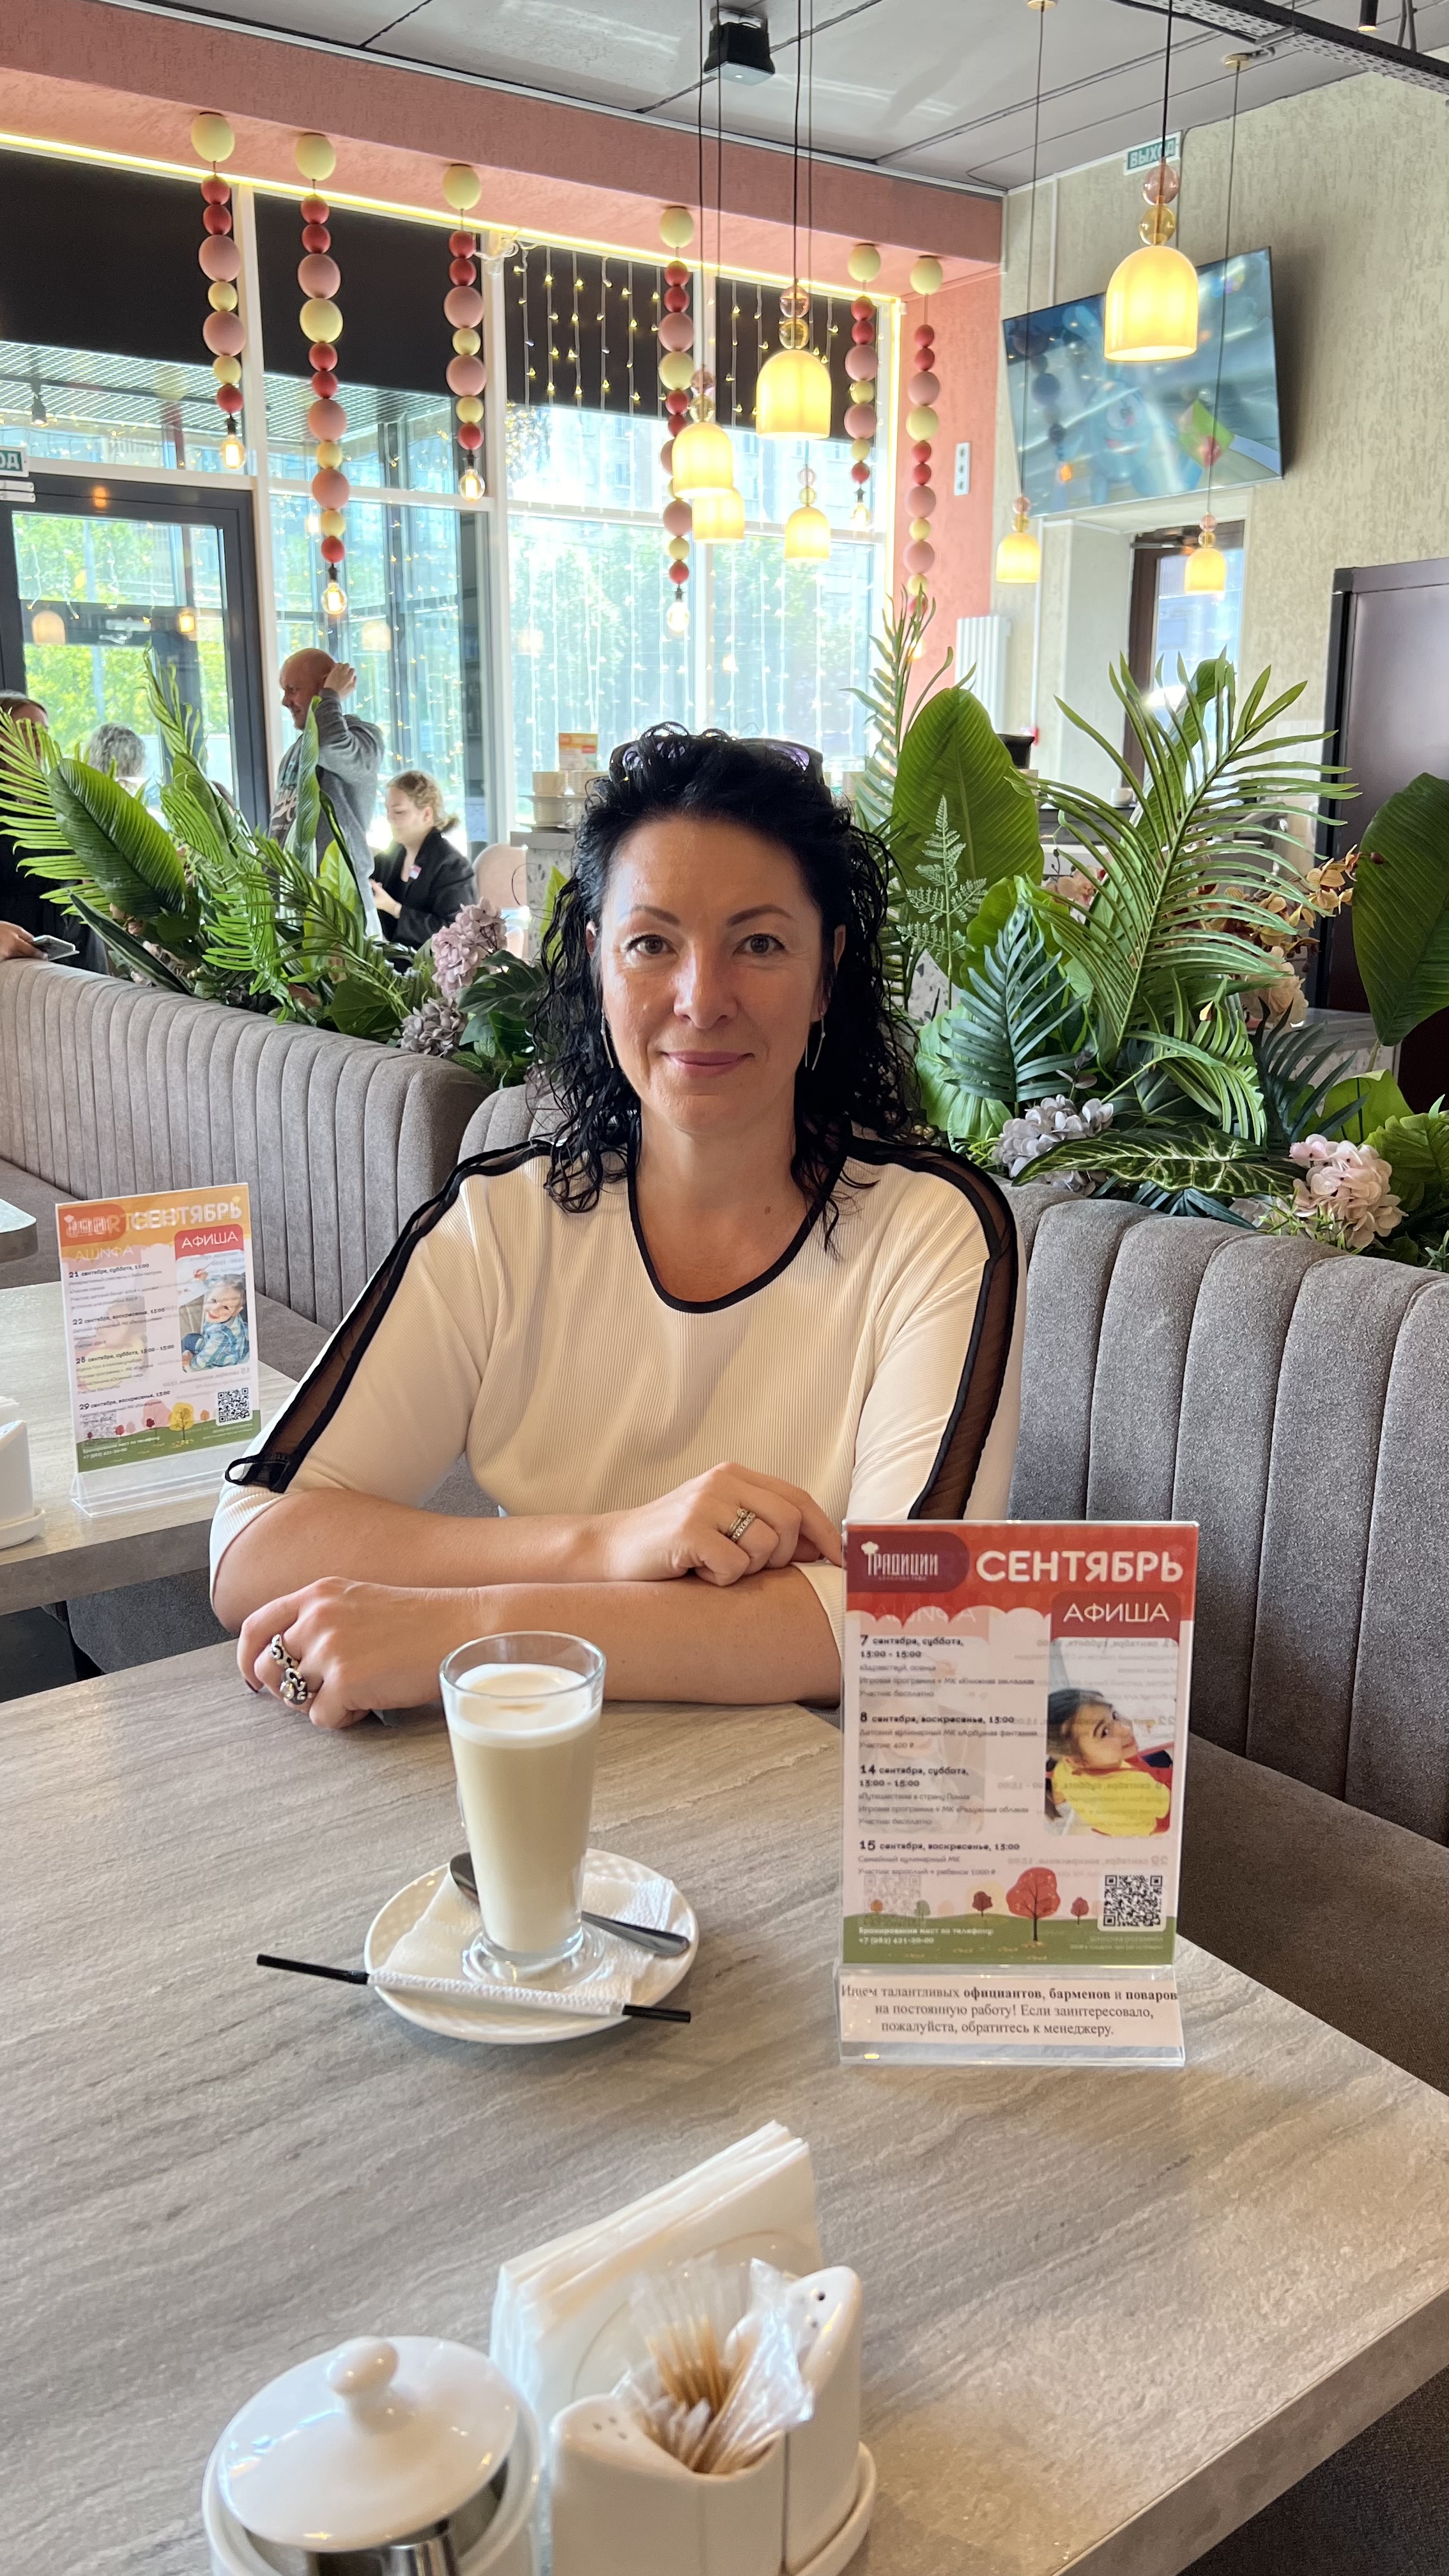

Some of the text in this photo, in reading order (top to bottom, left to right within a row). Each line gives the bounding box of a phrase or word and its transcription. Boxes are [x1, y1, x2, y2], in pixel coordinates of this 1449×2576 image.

[130, 1201, 243, 1230] СЕНТЯБРЬ
[181, 1230, 238, 1250] АФИША
[79, 1402, 89, 1411] 29
[864, 1549, 1184, 1584] ТРАДИЦИИ СЕНТЯБРЬ
[1062, 1602, 1170, 1623] АФИША
[860, 1634, 965, 1647] 7 сентября, суббота,
[860, 1712, 868, 1722] 8
[872, 1715, 919, 1724] сентября,
[860, 1764, 876, 1775] 14
[928, 1767, 969, 1776] суббота,
[859, 1840, 875, 1850] 15
[879, 1843, 926, 1851] сентября,
[841, 1985, 1177, 2004] Ищем талантливых официантов, барменов и поваров
[875, 2004, 1154, 2020] на постоянную работу! Если заинтересовало,
[882, 2020, 1114, 2037] пожалуйста, обратитесь к менеджеру.
